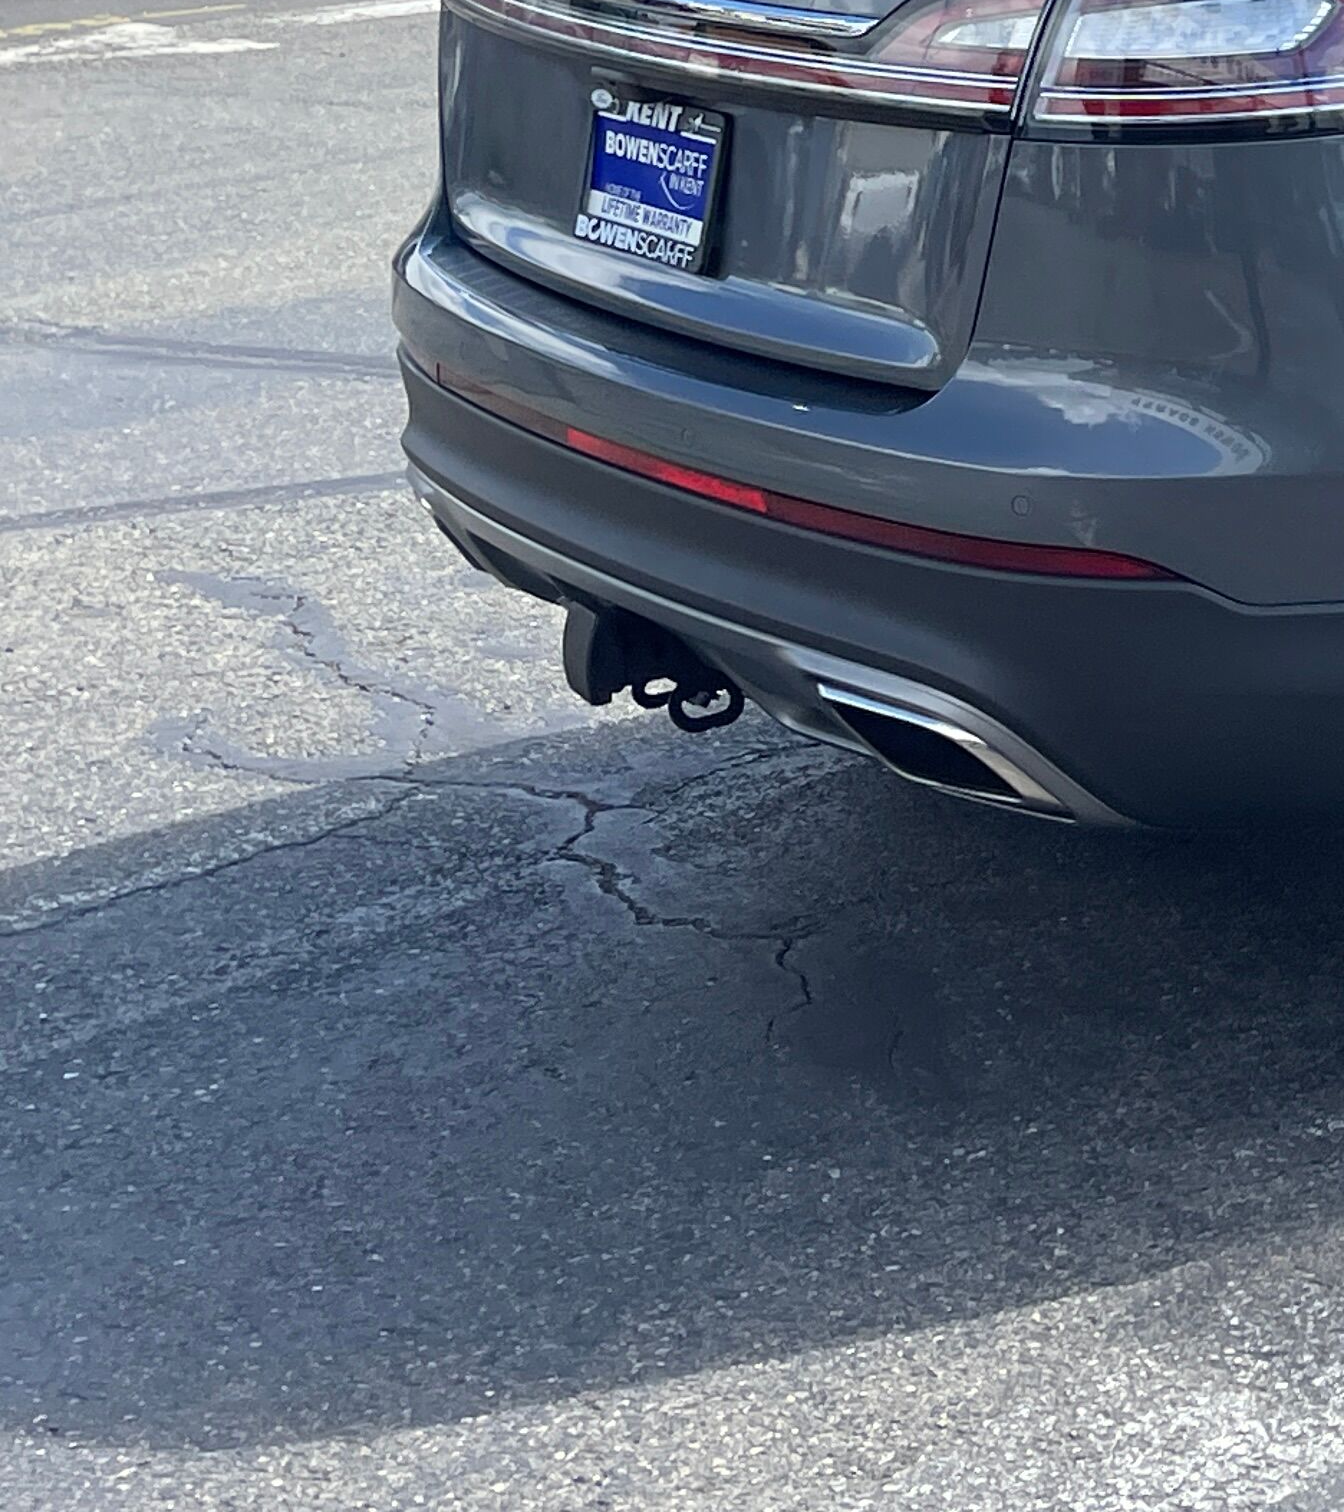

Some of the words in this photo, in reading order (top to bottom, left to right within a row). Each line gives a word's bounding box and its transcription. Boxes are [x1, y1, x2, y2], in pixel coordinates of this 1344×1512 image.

[625, 101, 683, 132] KENT
[604, 130, 708, 178] BOWENSCARFF
[601, 194, 641, 223] LIFETIME
[642, 205, 694, 236] WARRANTY
[575, 213, 695, 268] BOWENSCARFF
